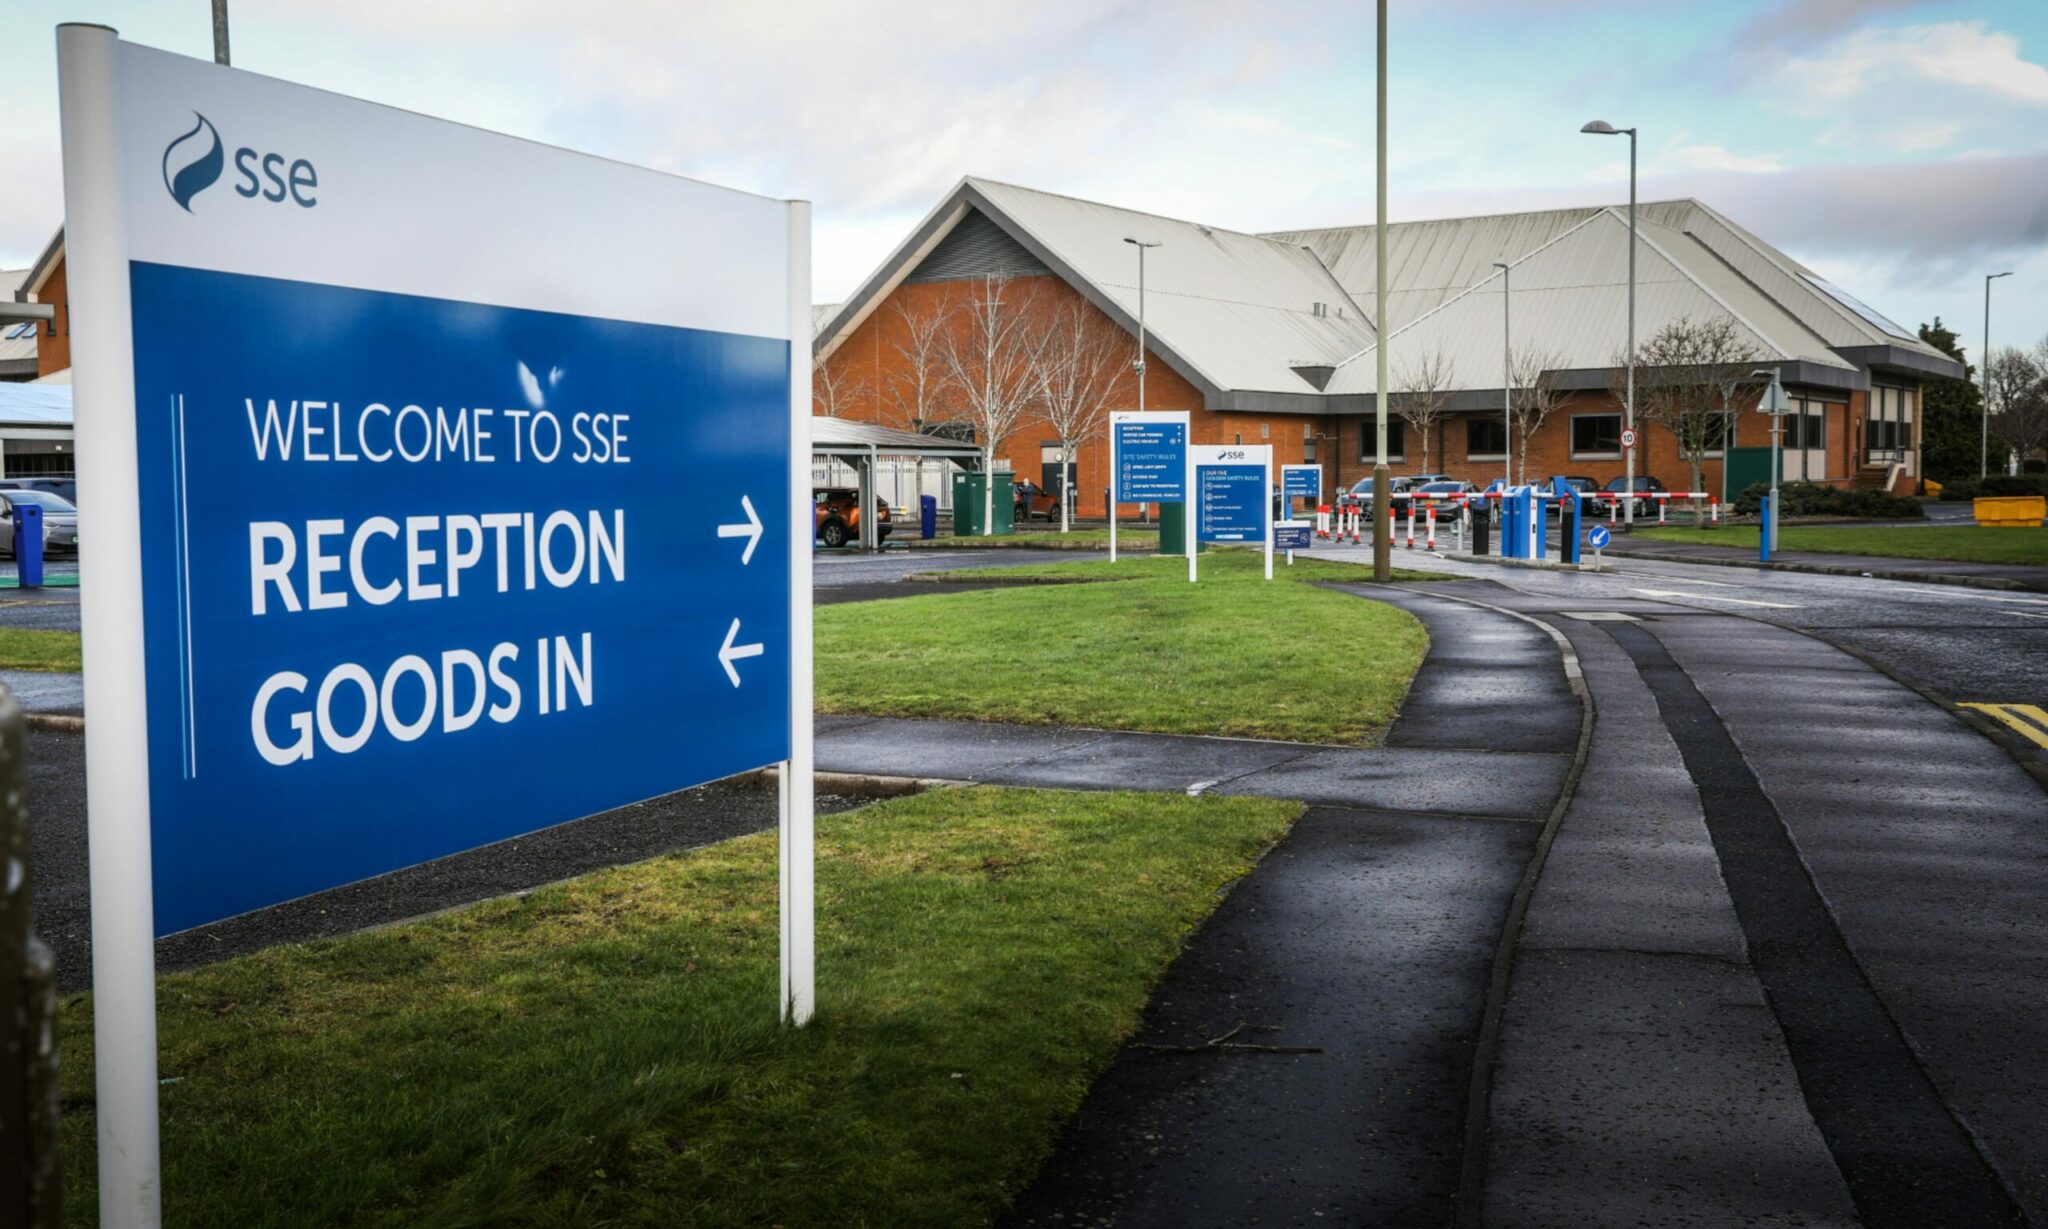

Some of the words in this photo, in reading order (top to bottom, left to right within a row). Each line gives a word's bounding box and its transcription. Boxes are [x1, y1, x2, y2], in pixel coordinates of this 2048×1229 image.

[235, 148, 317, 207] sse
[246, 399, 494, 461] WELCOME
[505, 410, 561, 463] TO
[573, 412, 630, 463] SSE
[1227, 451, 1245, 459] sse
[1623, 434, 1632, 443] 10
[250, 509, 625, 615] RECEPTION
[251, 642, 521, 766] GOODS
[538, 632, 592, 715] IN
